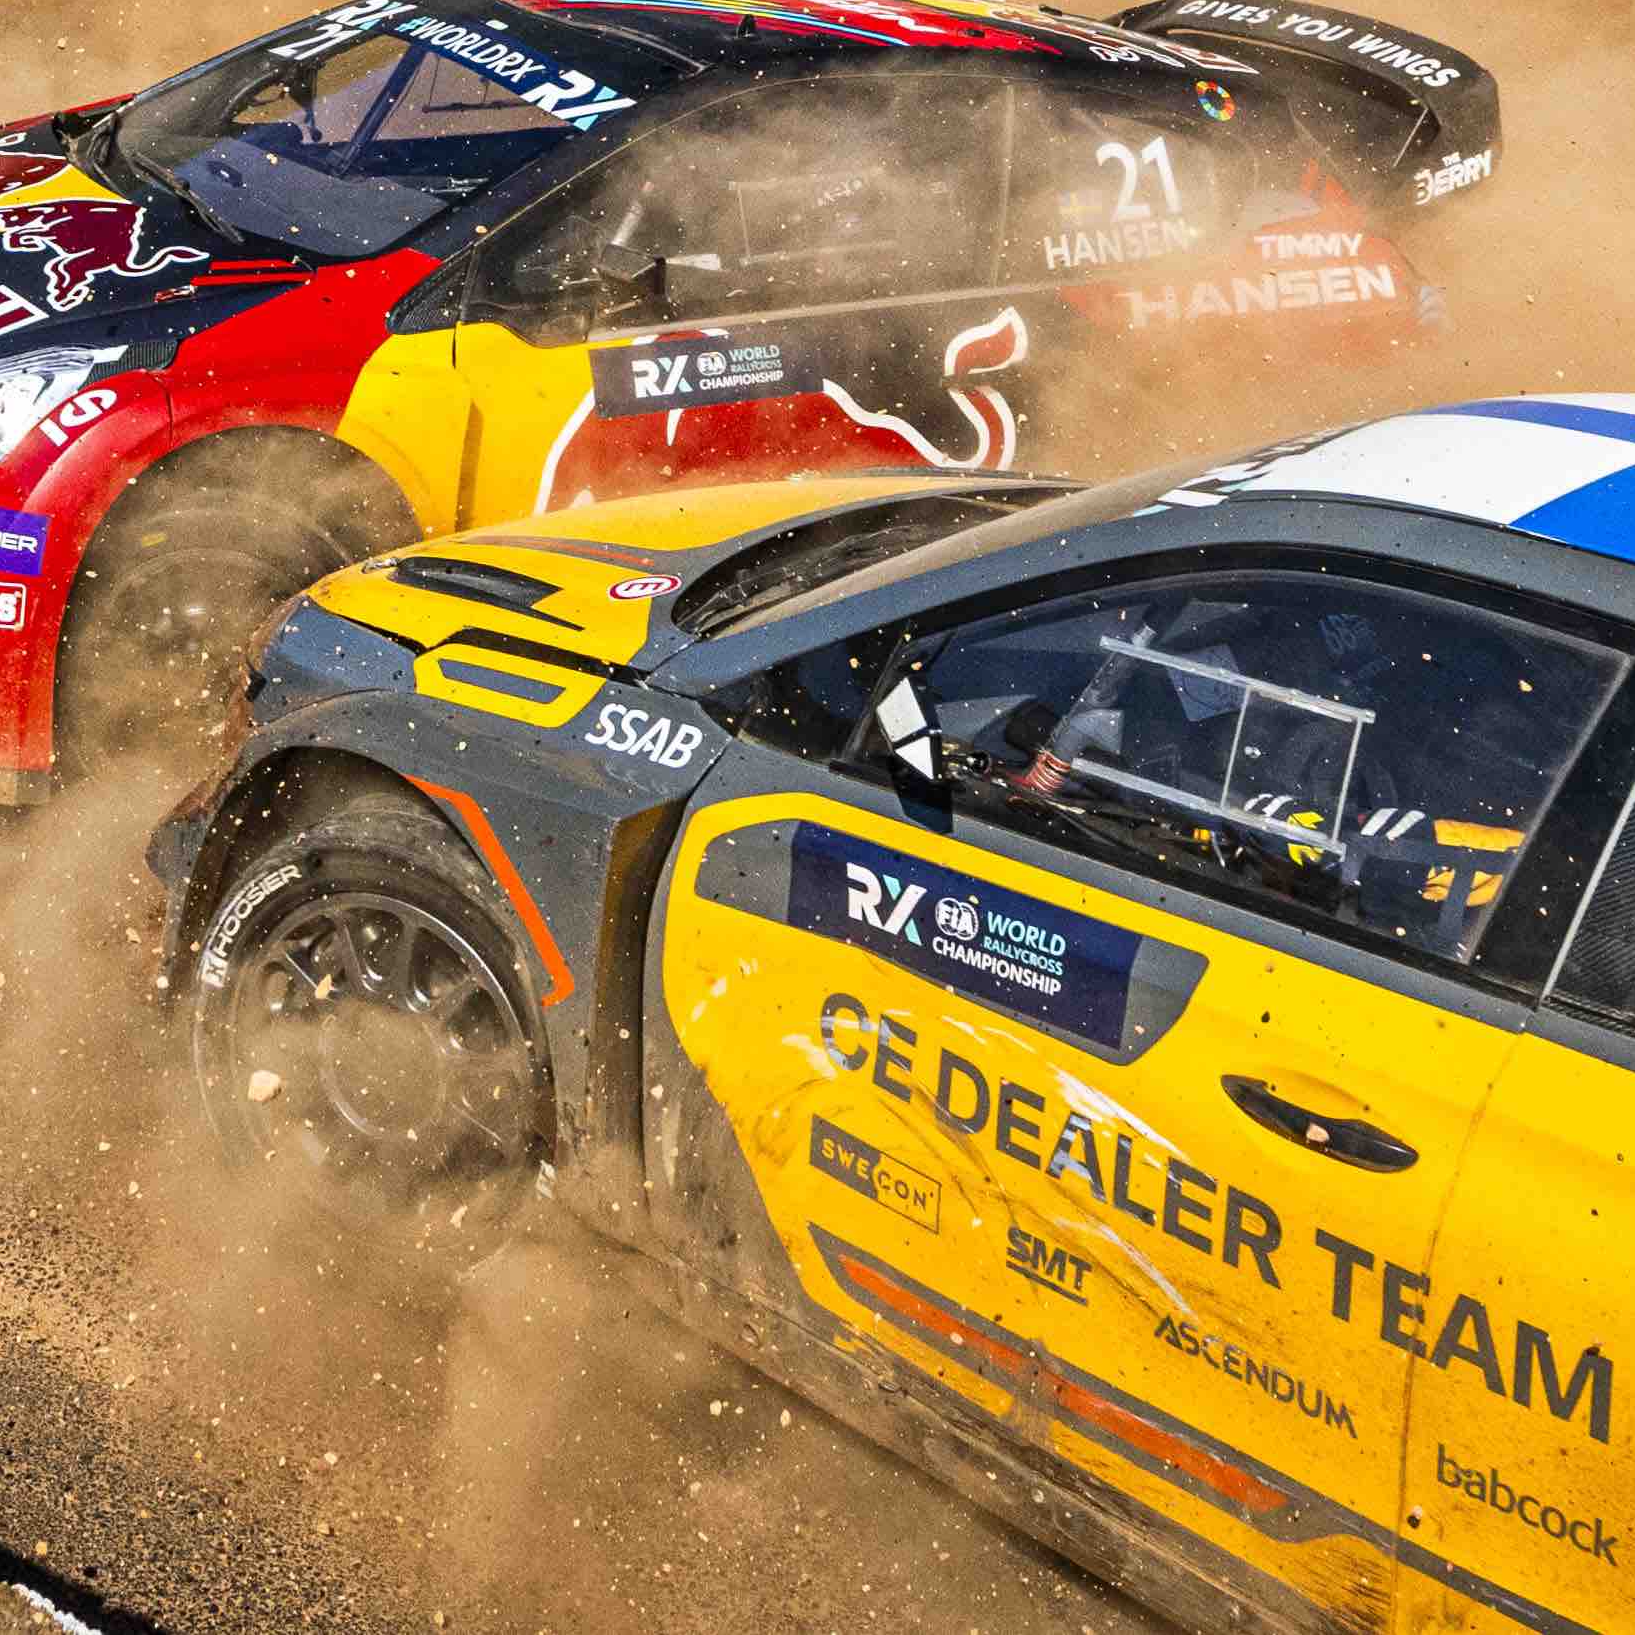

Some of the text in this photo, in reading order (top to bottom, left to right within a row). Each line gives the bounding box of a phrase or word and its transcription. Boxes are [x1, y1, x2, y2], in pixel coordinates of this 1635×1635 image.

[268, 22, 365, 60] 21
[395, 15, 547, 82] #WORLDRX
[1176, 0, 1462, 89] GIVES YOU WINGS
[520, 68, 638, 132] RX
[1095, 135, 1182, 221] 21
[1043, 218, 1192, 271] HANSEN
[1254, 232, 1364, 260] TIMMY
[1124, 264, 1397, 328] HANSEN
[631, 354, 694, 399] RX
[698, 370, 784, 391] CHAMPIONSHIP
[729, 344, 780, 362] WORLD
[585, 702, 704, 768] SSAB
[217, 863, 303, 958] HOOSIER
[845, 861, 928, 947] RX
[936, 899, 979, 940] FIA
[986, 909, 1067, 956] WORLD
[932, 935, 1063, 997] CHAMPIONSHIP
[982, 937, 1065, 977] RALLYCROSS
[821, 1137, 927, 1213] SWECON
[819, 992, 1615, 1446] CE DEALER TEAM
[1005, 1224, 1094, 1292] SMT
[1153, 1313, 1359, 1440] ASCENDUM
[1436, 1444, 1618, 1567] babcock
